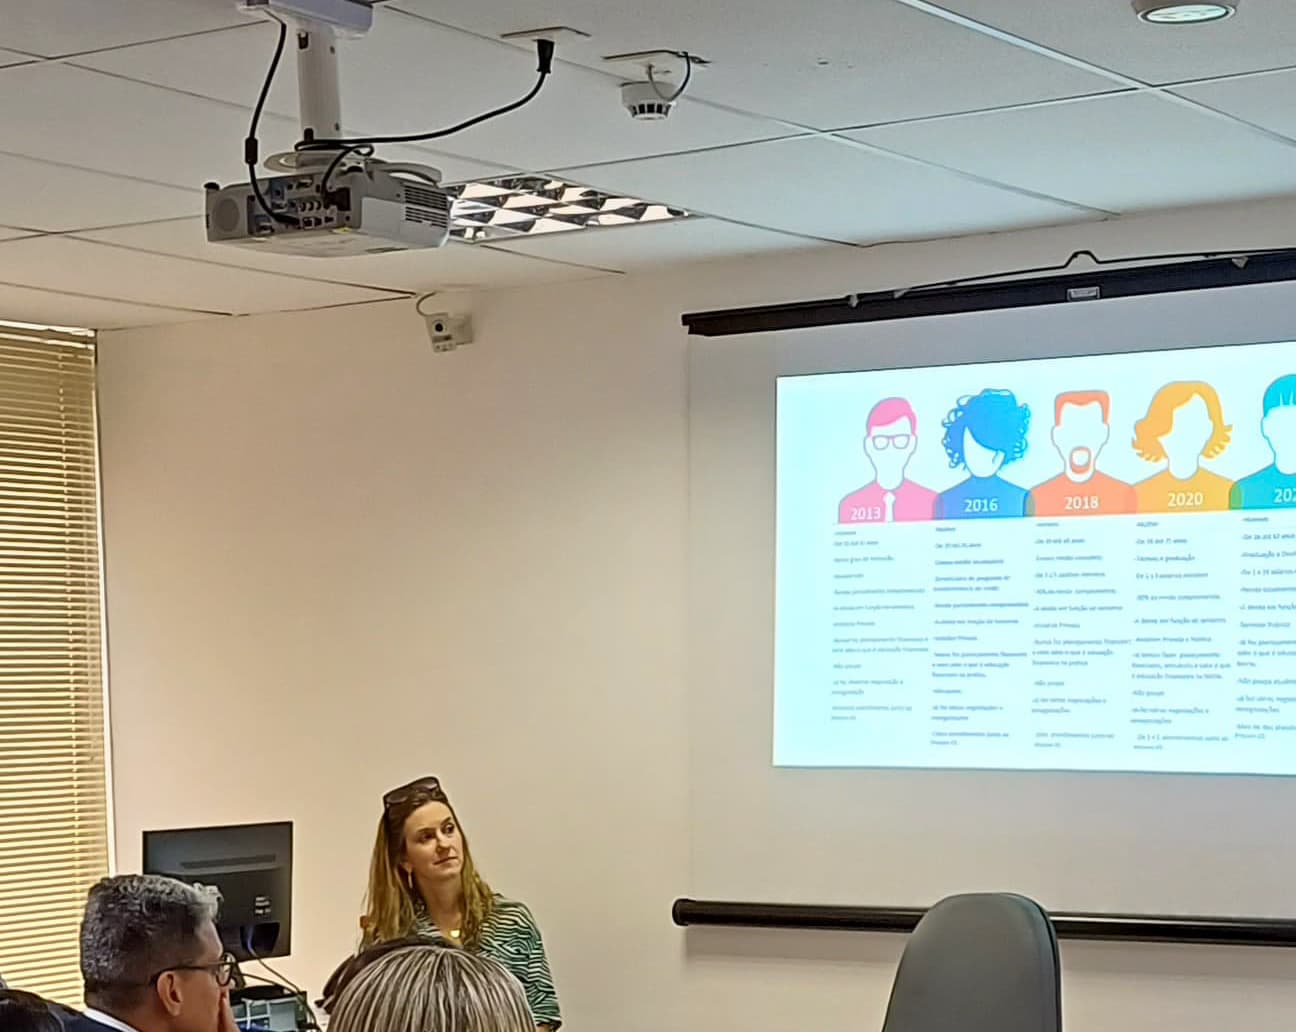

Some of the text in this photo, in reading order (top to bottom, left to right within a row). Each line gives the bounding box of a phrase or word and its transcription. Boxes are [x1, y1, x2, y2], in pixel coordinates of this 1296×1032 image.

[964, 499, 999, 513] 2016
[1064, 496, 1099, 511] 2018
[1167, 492, 1204, 508] 2020
[850, 507, 882, 521] 2013
